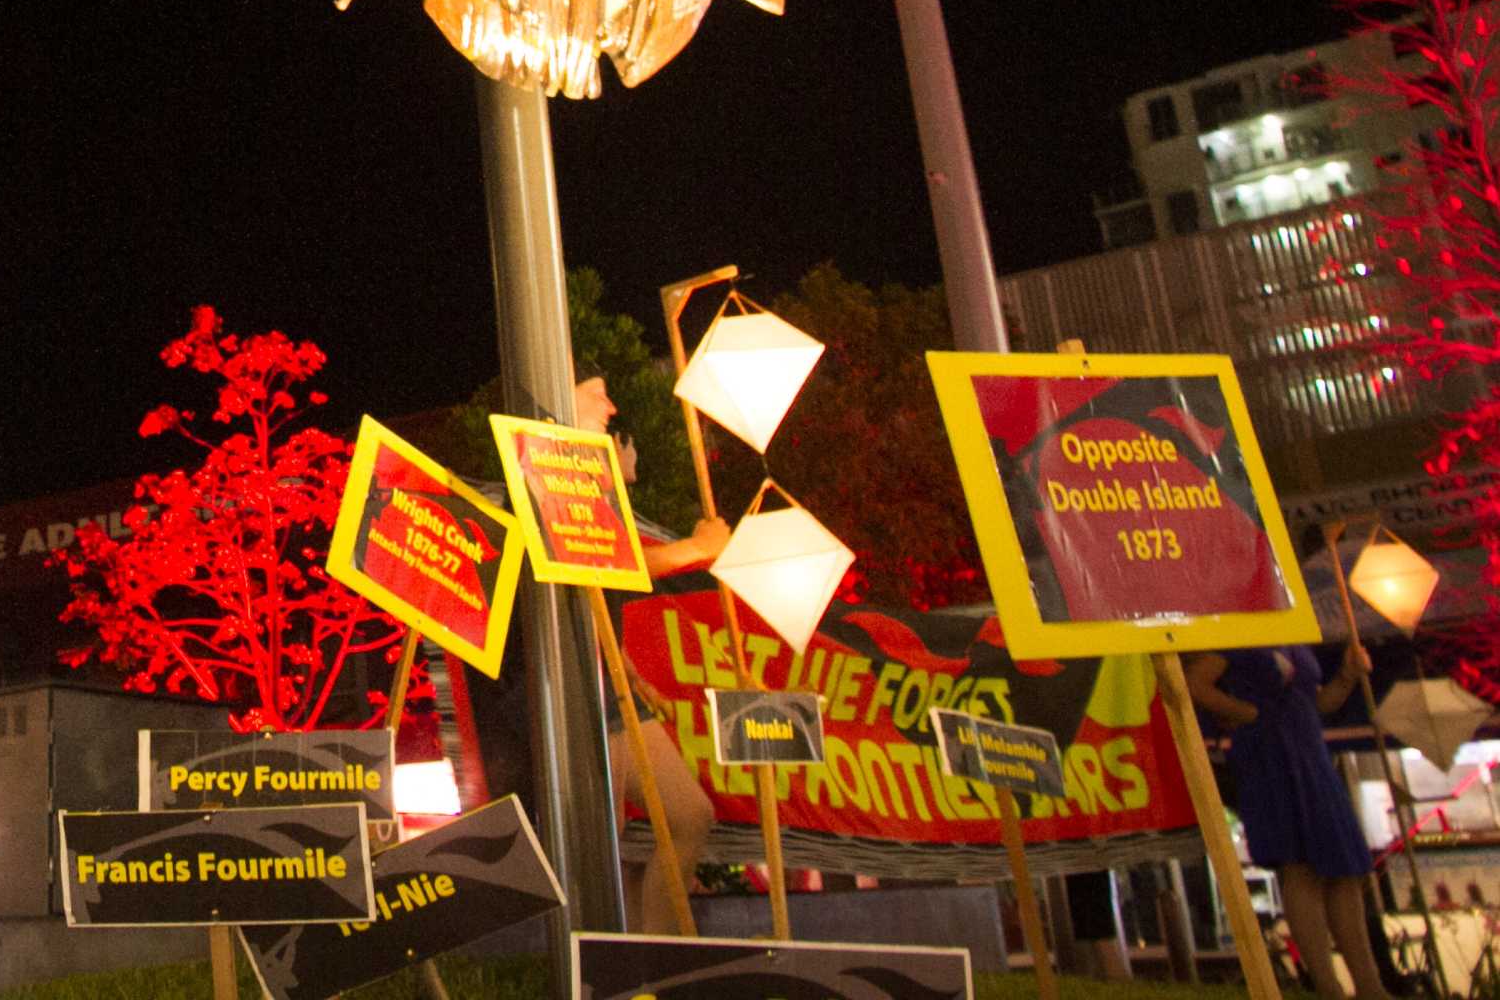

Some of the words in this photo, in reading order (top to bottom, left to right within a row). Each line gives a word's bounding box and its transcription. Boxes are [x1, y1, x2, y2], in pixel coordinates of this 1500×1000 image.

[1060, 430, 1178, 471] Opposite
[543, 474, 577, 494] White
[1047, 478, 1143, 513] Double
[1142, 476, 1222, 511] Island
[392, 487, 444, 536] Wrights
[445, 525, 484, 565] Creek
[1117, 528, 1183, 561] 1873
[406, 527, 461, 573] 1876-77
[169, 765, 248, 798] Percy
[254, 763, 382, 792] Fourmile
[76, 852, 192, 884] Francis
[197, 847, 347, 882] Fourmile
